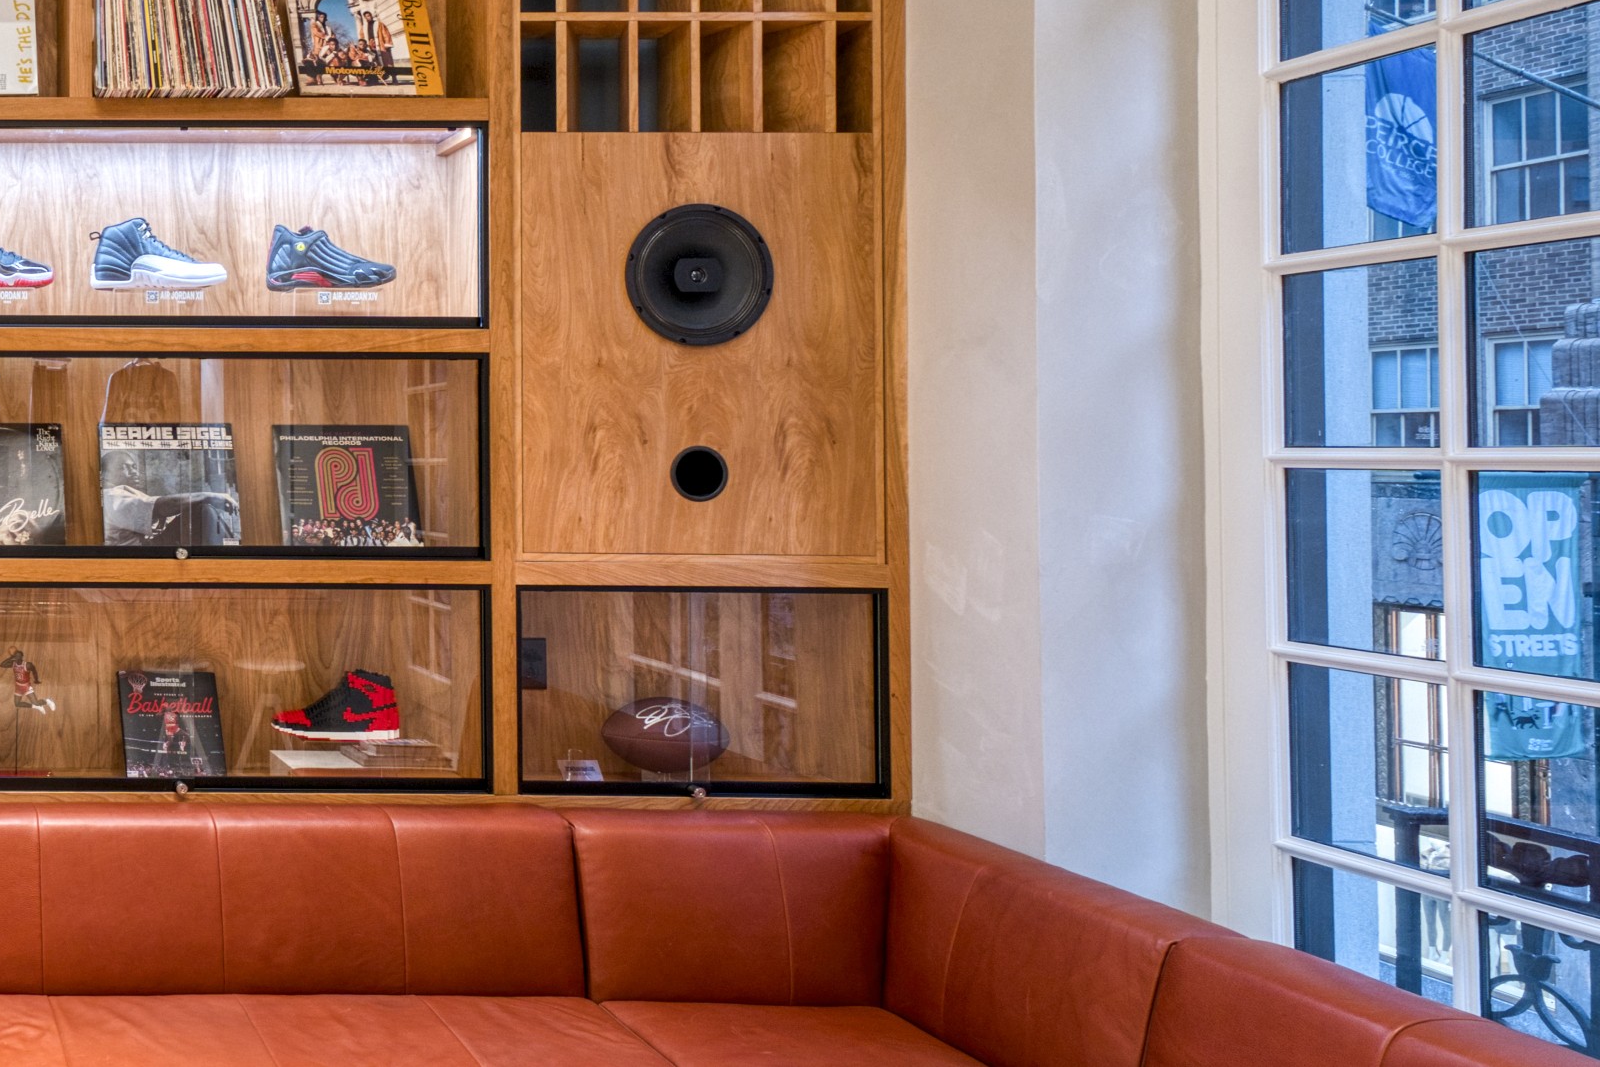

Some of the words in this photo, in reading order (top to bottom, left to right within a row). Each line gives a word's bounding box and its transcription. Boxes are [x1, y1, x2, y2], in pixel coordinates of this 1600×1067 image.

[12, 0, 31, 21] DJ
[15, 25, 32, 53] THE
[408, 31, 431, 46] II
[15, 58, 33, 84] HE'S
[411, 48, 436, 89] Men
[1366, 139, 1437, 179] COLLEGE
[161, 291, 171, 300] AIR
[171, 291, 195, 300] JORDAN
[332, 292, 343, 301] AIR
[343, 292, 367, 301] JORDAN
[176, 426, 233, 440] SIGEL
[1479, 489, 1578, 563] OP
[1480, 556, 1576, 630] EN
[1489, 633, 1578, 658] STREETS
[150, 680, 187, 688] Illustrated
[127, 692, 213, 714] Basketball
